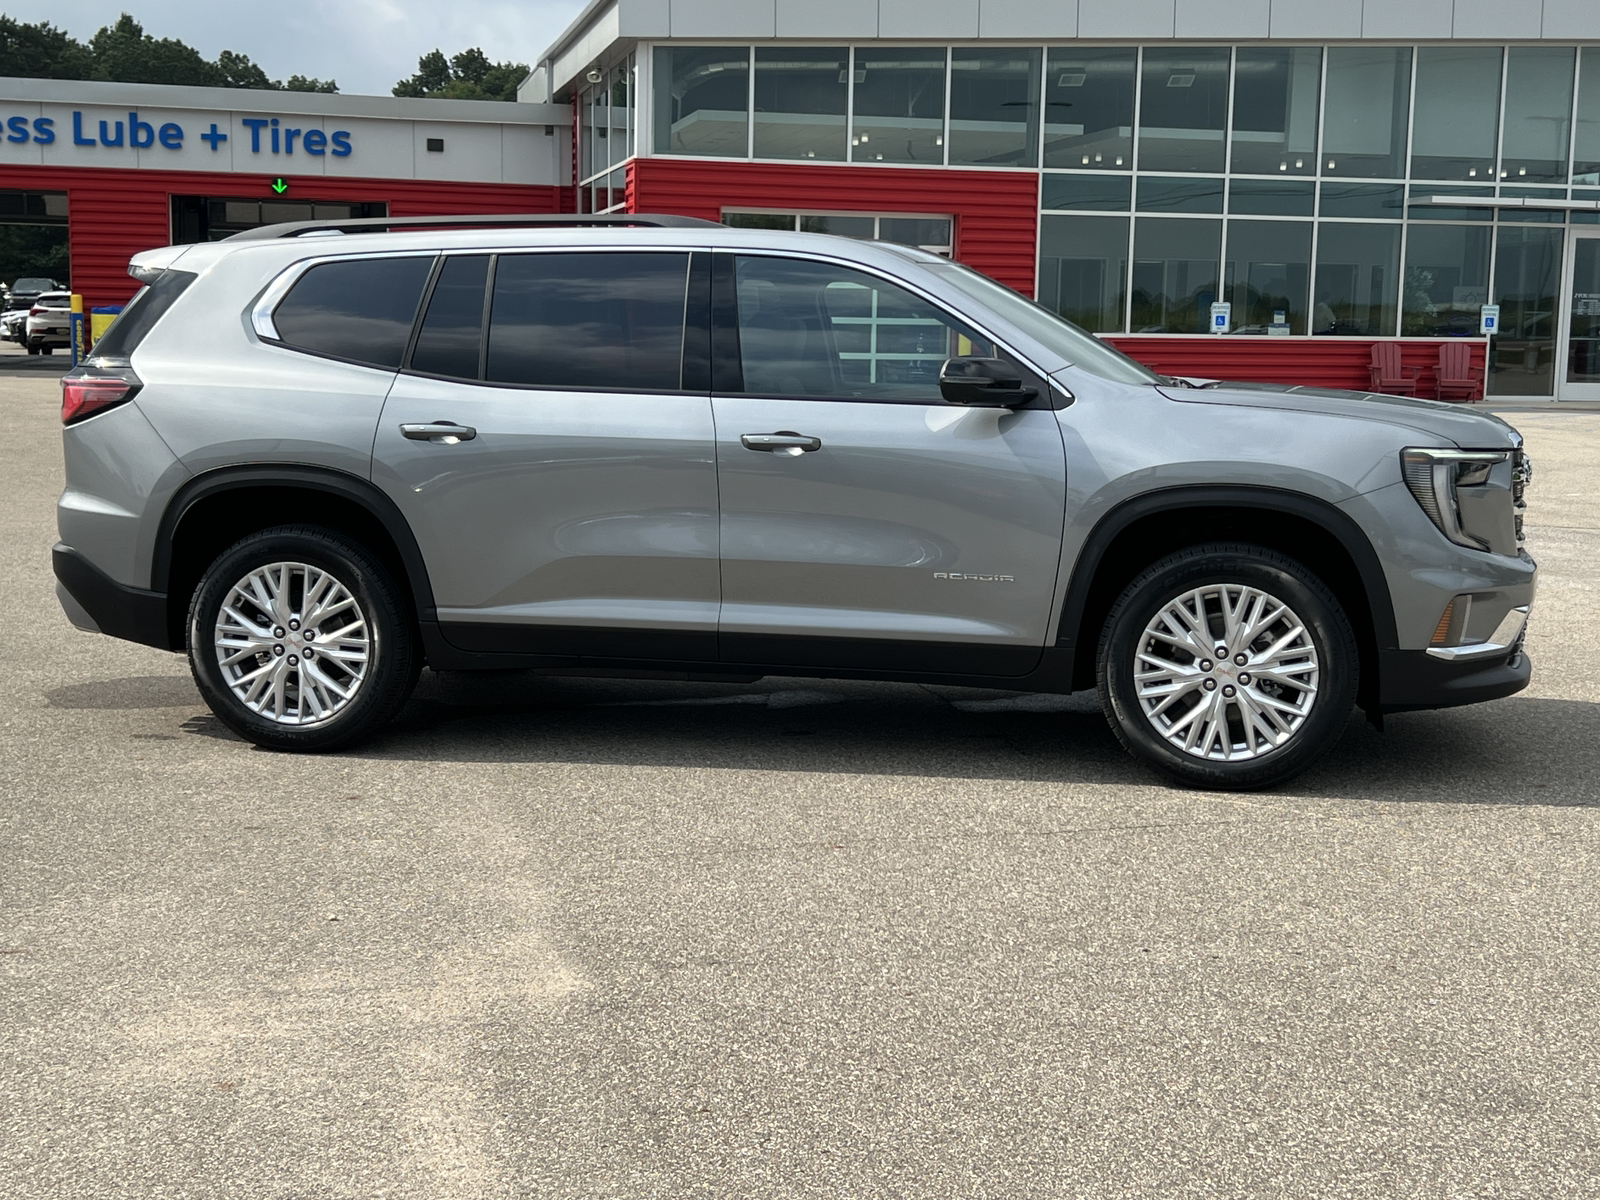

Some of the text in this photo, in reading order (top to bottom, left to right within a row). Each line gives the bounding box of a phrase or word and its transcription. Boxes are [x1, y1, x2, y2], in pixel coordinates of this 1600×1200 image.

[0, 111, 353, 157] ss Lube + Tires
[933, 572, 1015, 582] ACADIA
[1216, 667, 1235, 678] GMC
